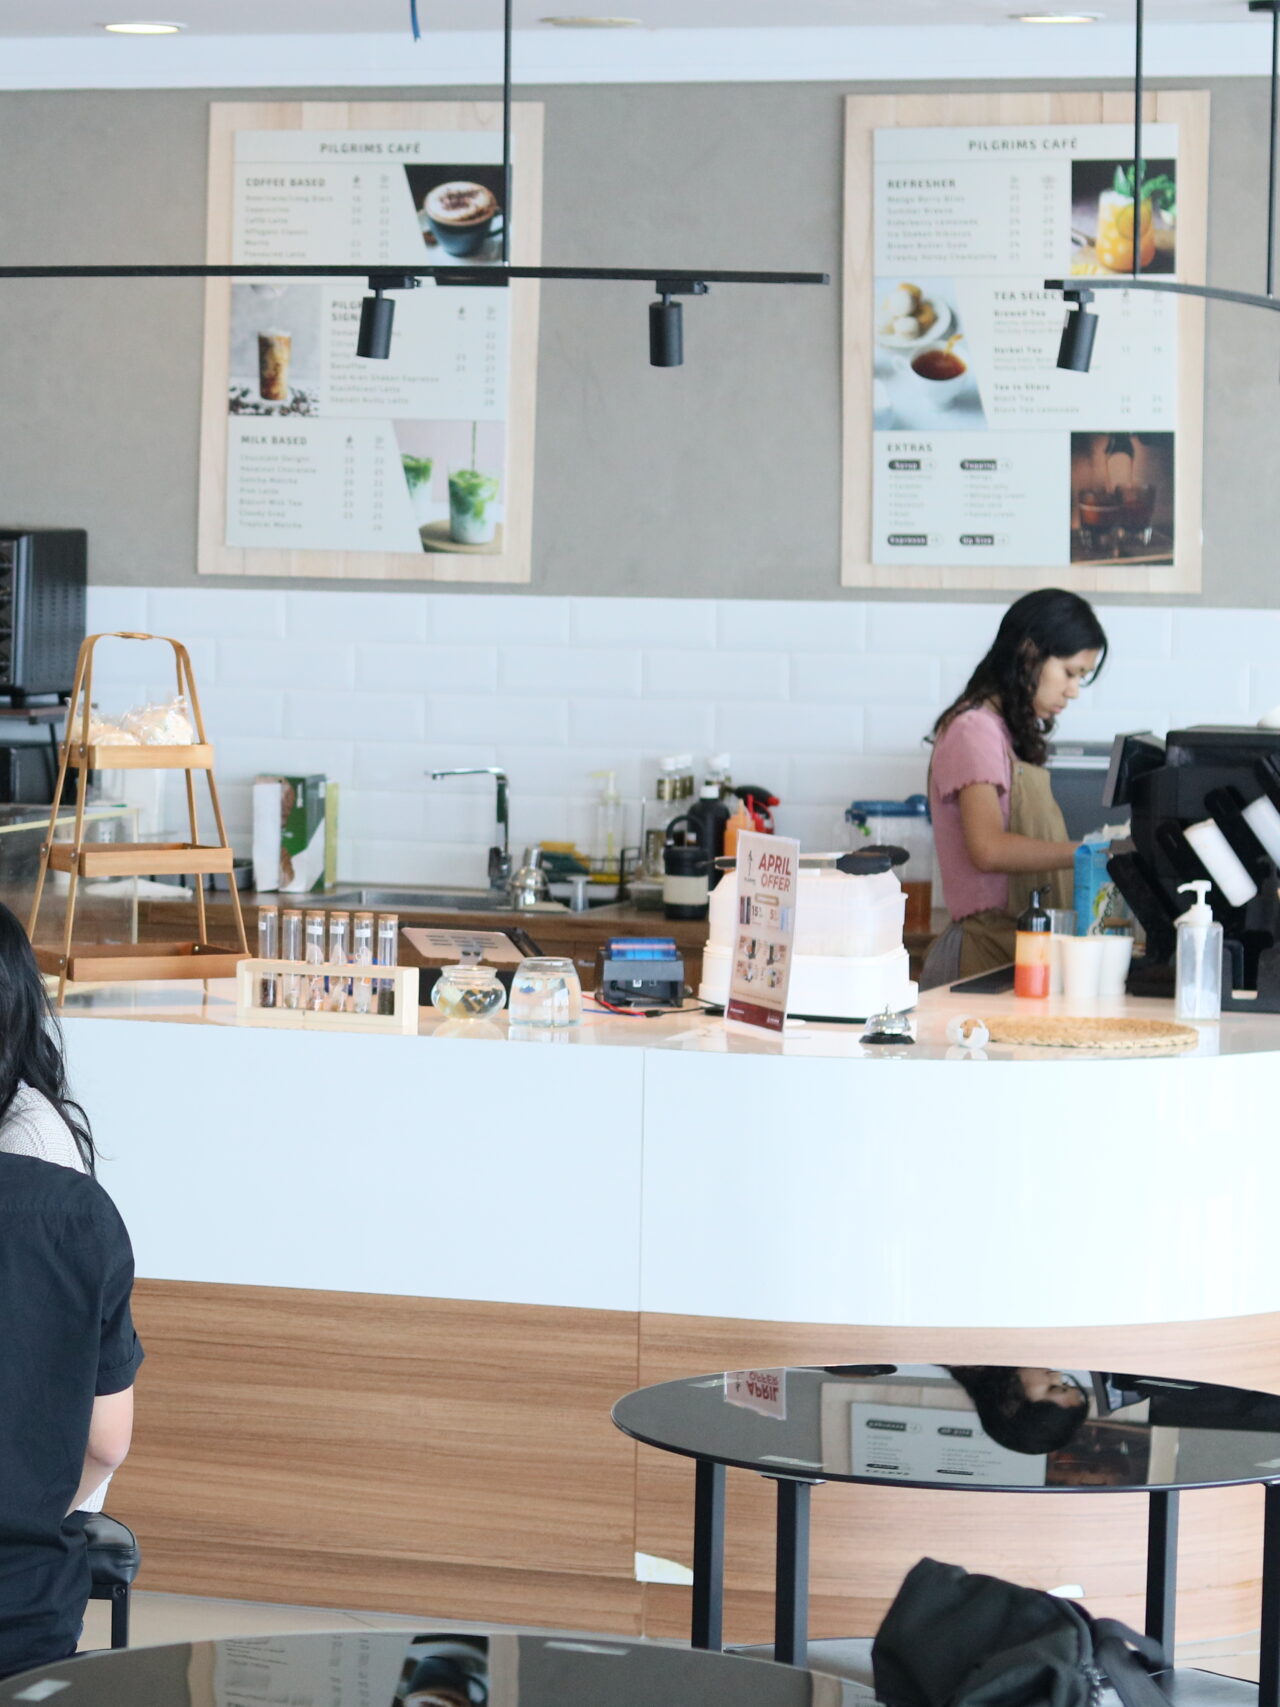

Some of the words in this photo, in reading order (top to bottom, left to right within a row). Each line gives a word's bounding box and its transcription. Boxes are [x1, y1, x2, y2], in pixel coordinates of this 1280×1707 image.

[320, 143, 383, 154] PILGRIMS
[388, 142, 421, 154] CAFÉ
[968, 140, 1037, 151] PILGRIMS
[1042, 137, 1078, 150] CAFÉ
[245, 178, 285, 187] COFFEE
[290, 178, 326, 187] BASED
[887, 179, 956, 188] REFRESHER
[994, 291, 1016, 300] TEA
[240, 435, 267, 445] MILK
[272, 436, 308, 446] BASED
[887, 443, 933, 452] EXTRAS
[758, 851, 791, 876] APRIL
[761, 873, 791, 892] OFFER
